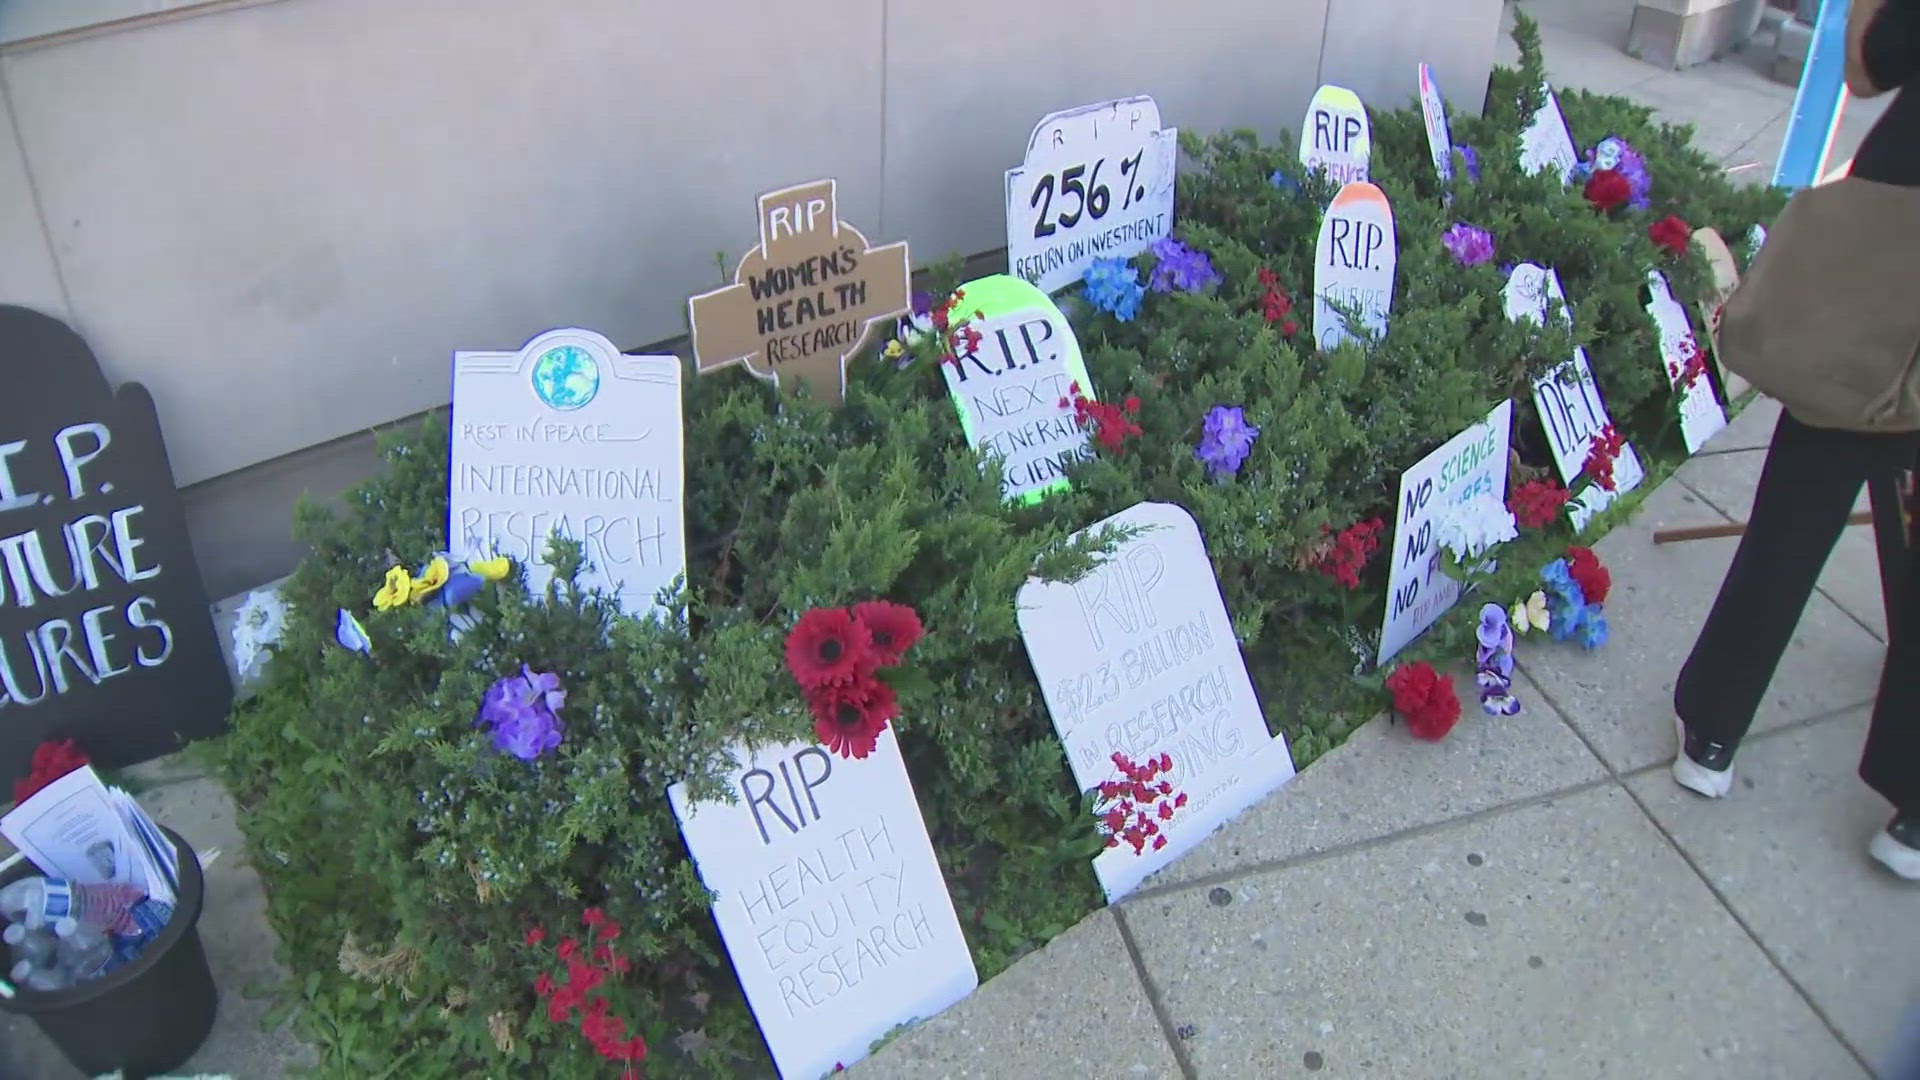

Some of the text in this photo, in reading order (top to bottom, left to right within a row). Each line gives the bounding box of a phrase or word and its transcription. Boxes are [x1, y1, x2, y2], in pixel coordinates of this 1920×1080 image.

[1315, 110, 1361, 152] RIP
[769, 198, 826, 241] RIP
[1016, 213, 1165, 280] RETURN ON INVESTMENT
[1329, 218, 1383, 272] R.I.P.
[749, 245, 858, 301] WOMEN'S
[757, 280, 867, 335] HEALTH
[766, 319, 858, 367] RESEARCH
[973, 373, 1066, 422] NEXT
[463, 416, 651, 450] REST IN PEACE
[460, 462, 673, 503] INTERNATIONAL
[1405, 428, 1496, 525] NO SCIENCE
[0, 504, 161, 607] TURE
[462, 507, 666, 588] RESEARCH
[1404, 519, 1431, 570] NO
[1073, 543, 1165, 651] RIP
[1393, 577, 1418, 621] NO
[0, 597, 173, 709] URES
[1121, 610, 1215, 689] BILLION
[1105, 665, 1232, 757] RESEARCH
[740, 746, 832, 846] RIP
[738, 815, 896, 925] HEALTH
[757, 861, 904, 972] EQUITY
[778, 903, 935, 1019] RESEARCH
